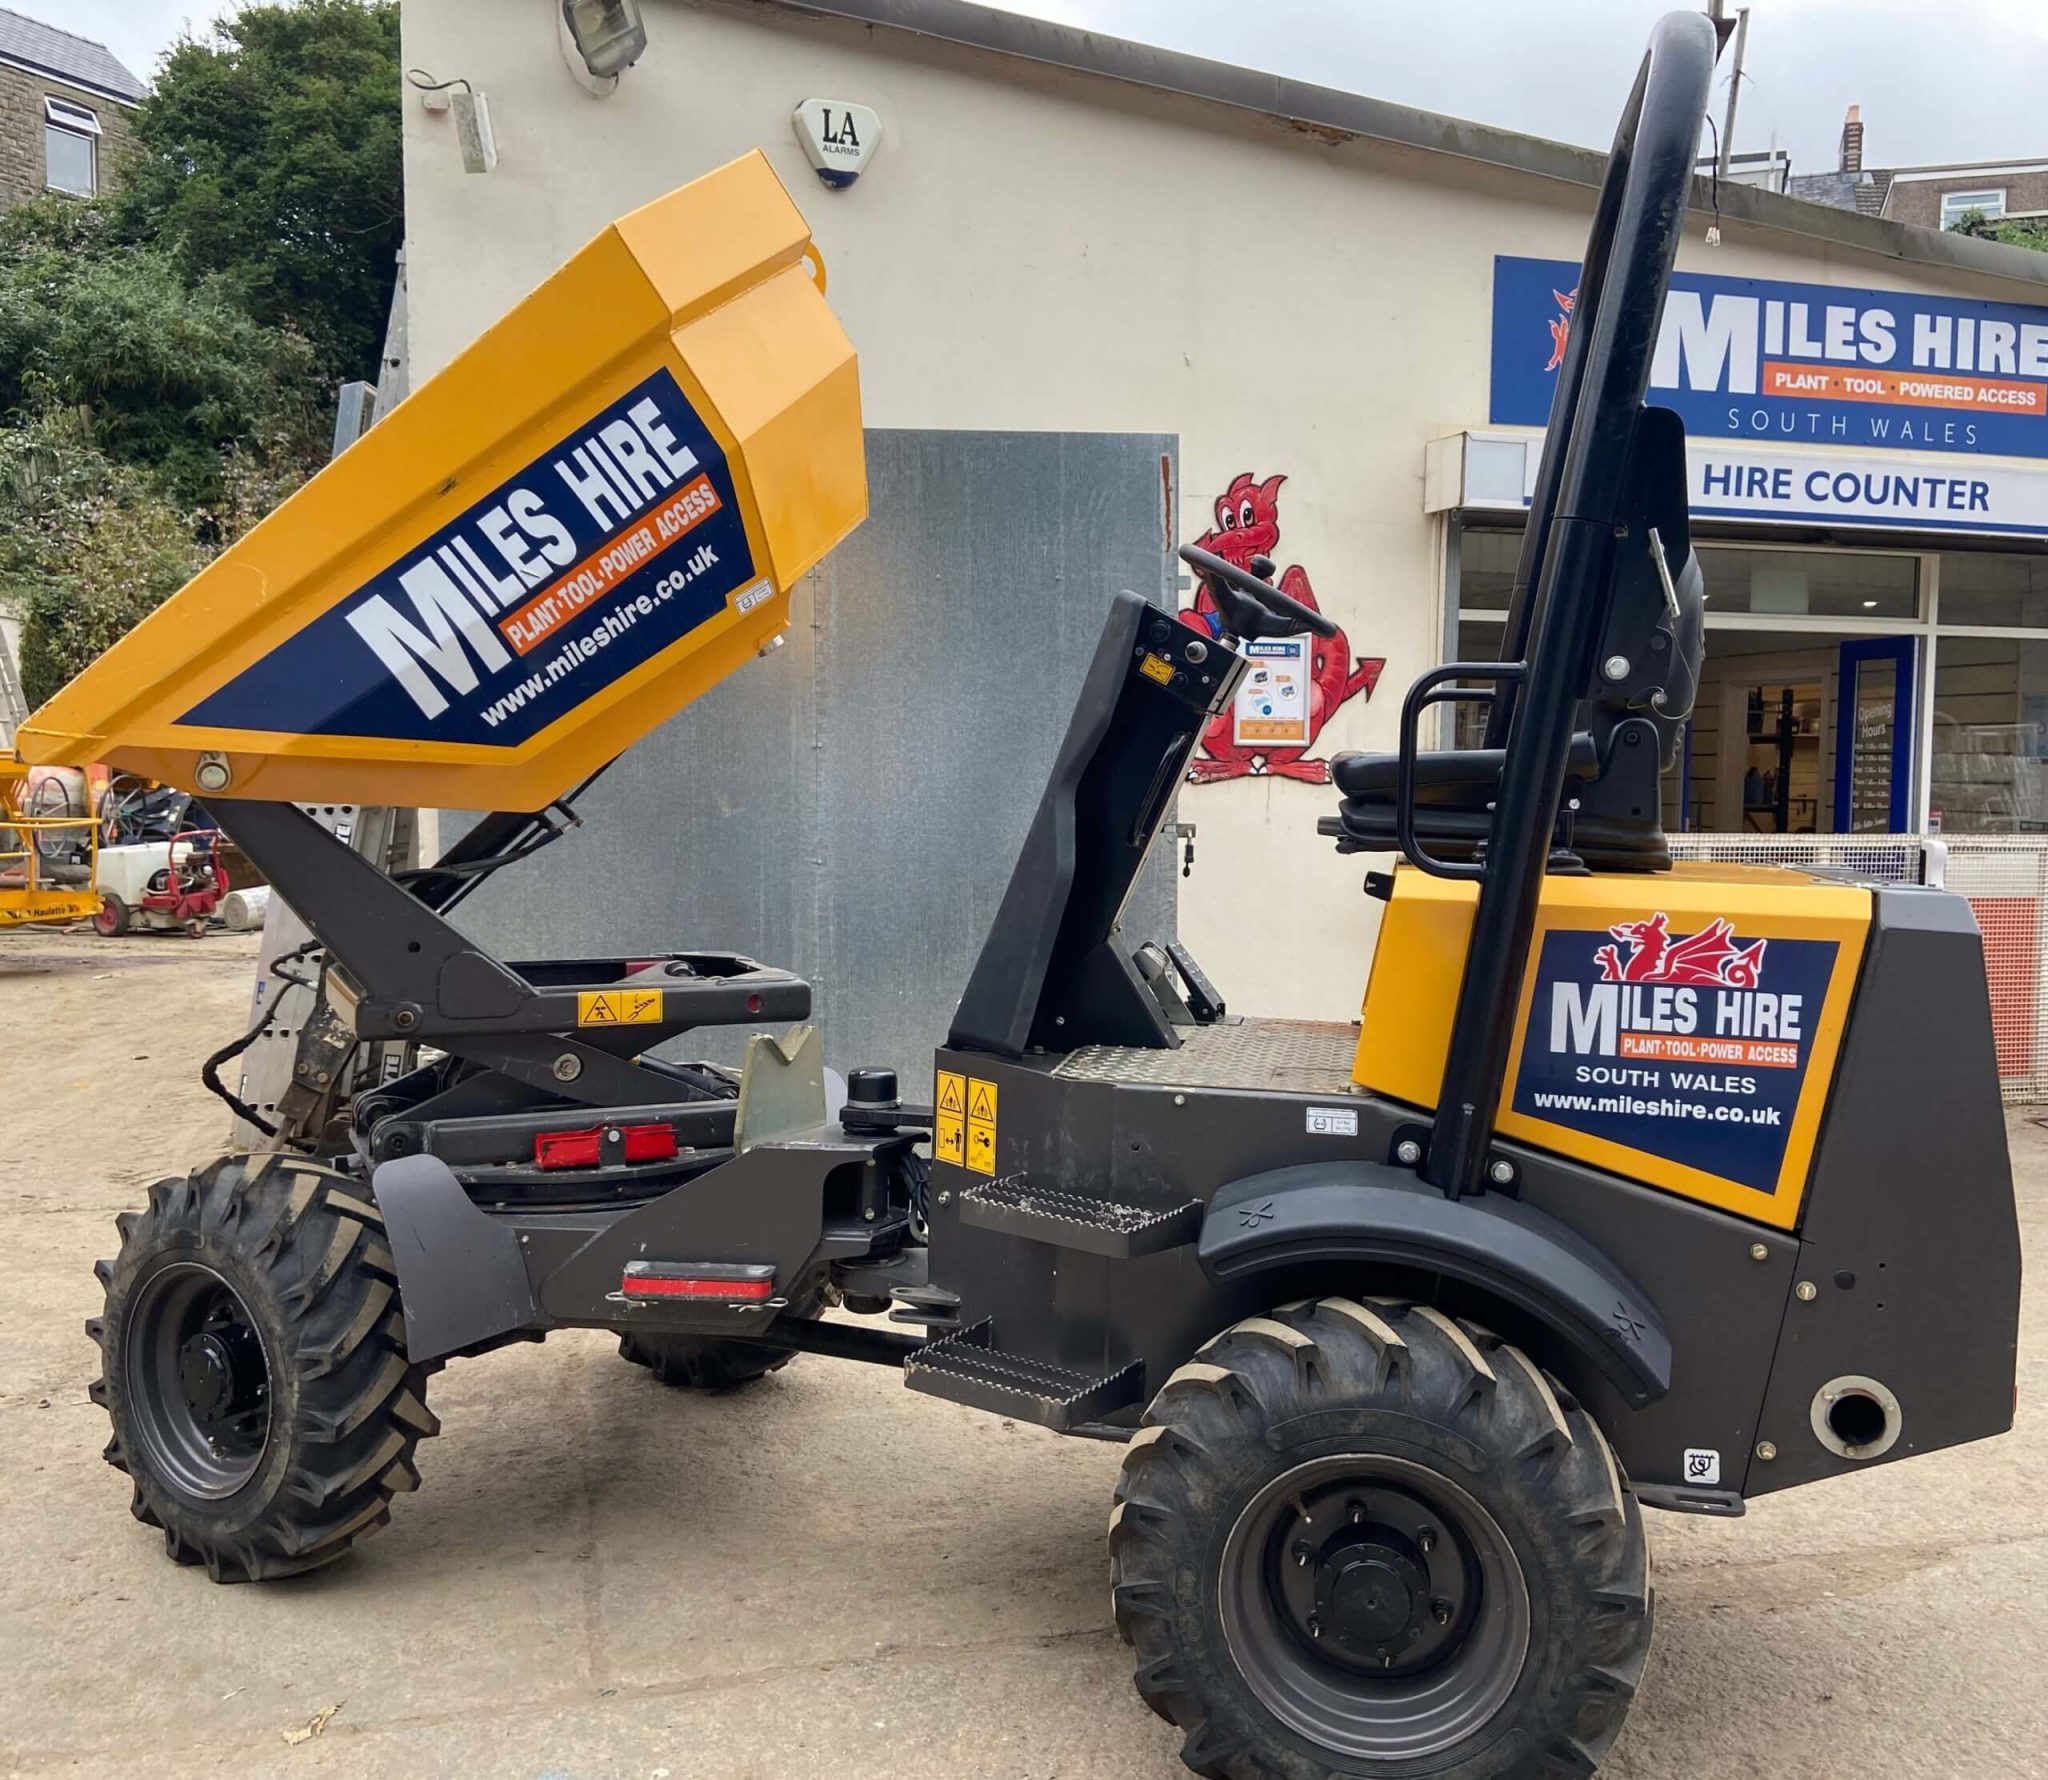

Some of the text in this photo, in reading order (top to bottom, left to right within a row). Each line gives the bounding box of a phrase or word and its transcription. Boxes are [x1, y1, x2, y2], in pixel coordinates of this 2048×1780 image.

[822, 108, 860, 147] LA
[822, 144, 860, 157] ALARMS
[1651, 290, 2048, 394] MILES HIRE
[1775, 372, 2037, 406] PLANT TOOL POWERED ACCESS
[1728, 408, 1977, 445] SOUTH WALES
[1703, 463, 1990, 512] HIRE COUNTER
[658, 484, 716, 539] ACCESS
[345, 397, 699, 720] MILES HIRE
[480, 545, 720, 727] www.mileshire.co.uk
[1858, 703, 1892, 722] Opening
[1862, 723, 1886, 739] Hours
[1549, 981, 1803, 1056] MILES HIRE
[1747, 1046, 1797, 1064] ACCESS
[1576, 1065, 1757, 1094] SOUTH WALES
[1534, 1092, 1781, 1126] www.mileshire.co.uk
